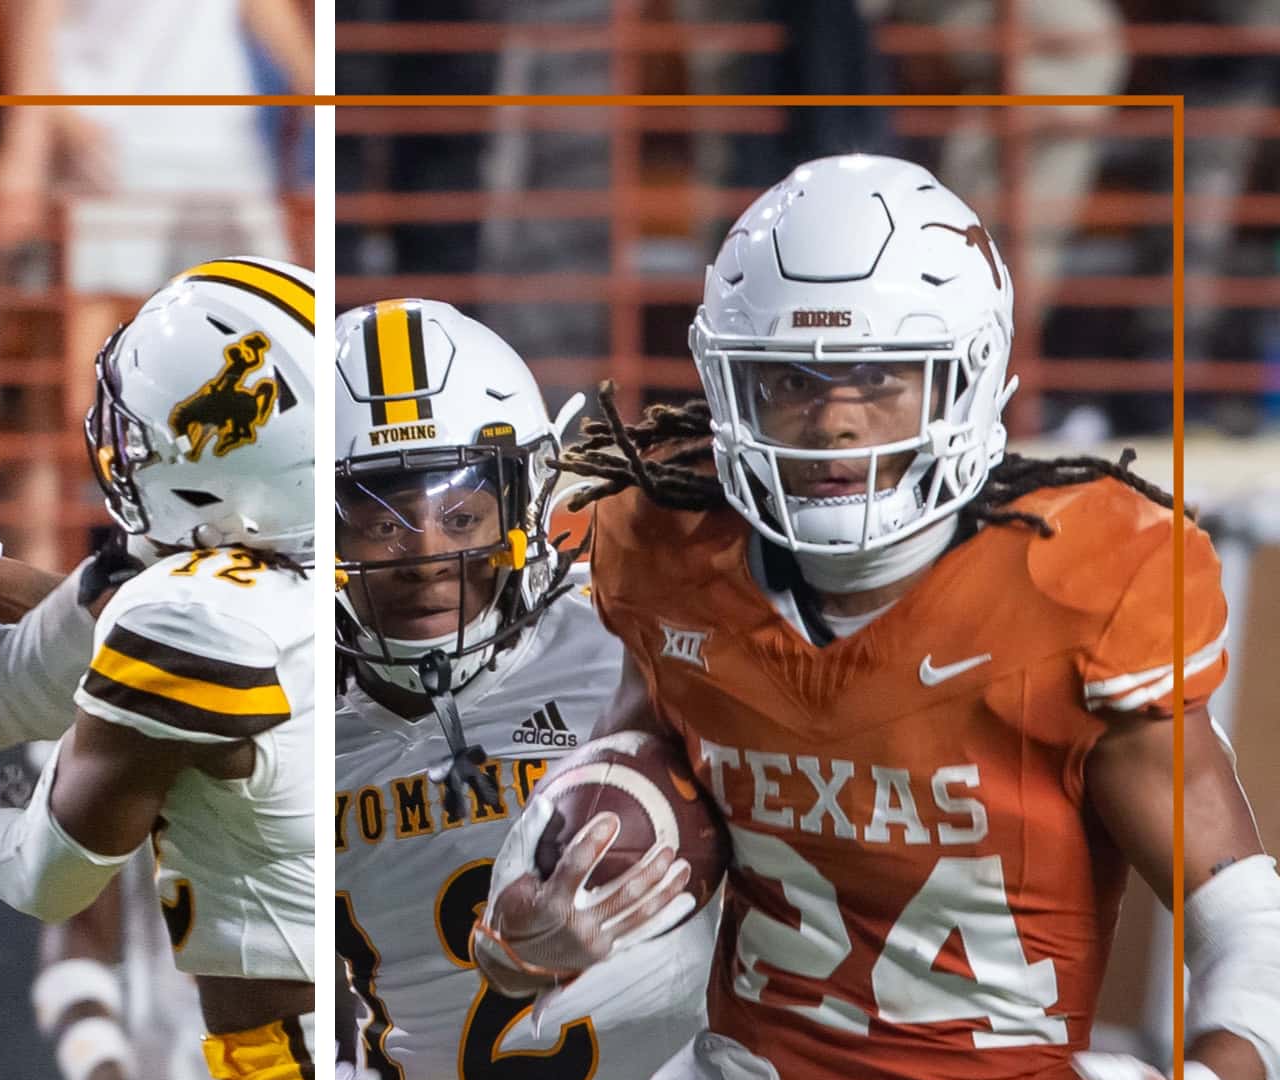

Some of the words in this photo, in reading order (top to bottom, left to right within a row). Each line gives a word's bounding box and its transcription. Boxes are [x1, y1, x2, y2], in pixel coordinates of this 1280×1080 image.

[368, 424, 436, 447] WYOMING
[512, 728, 578, 747] adidas
[700, 738, 990, 846] TEXAS
[728, 823, 1070, 1049] 24
